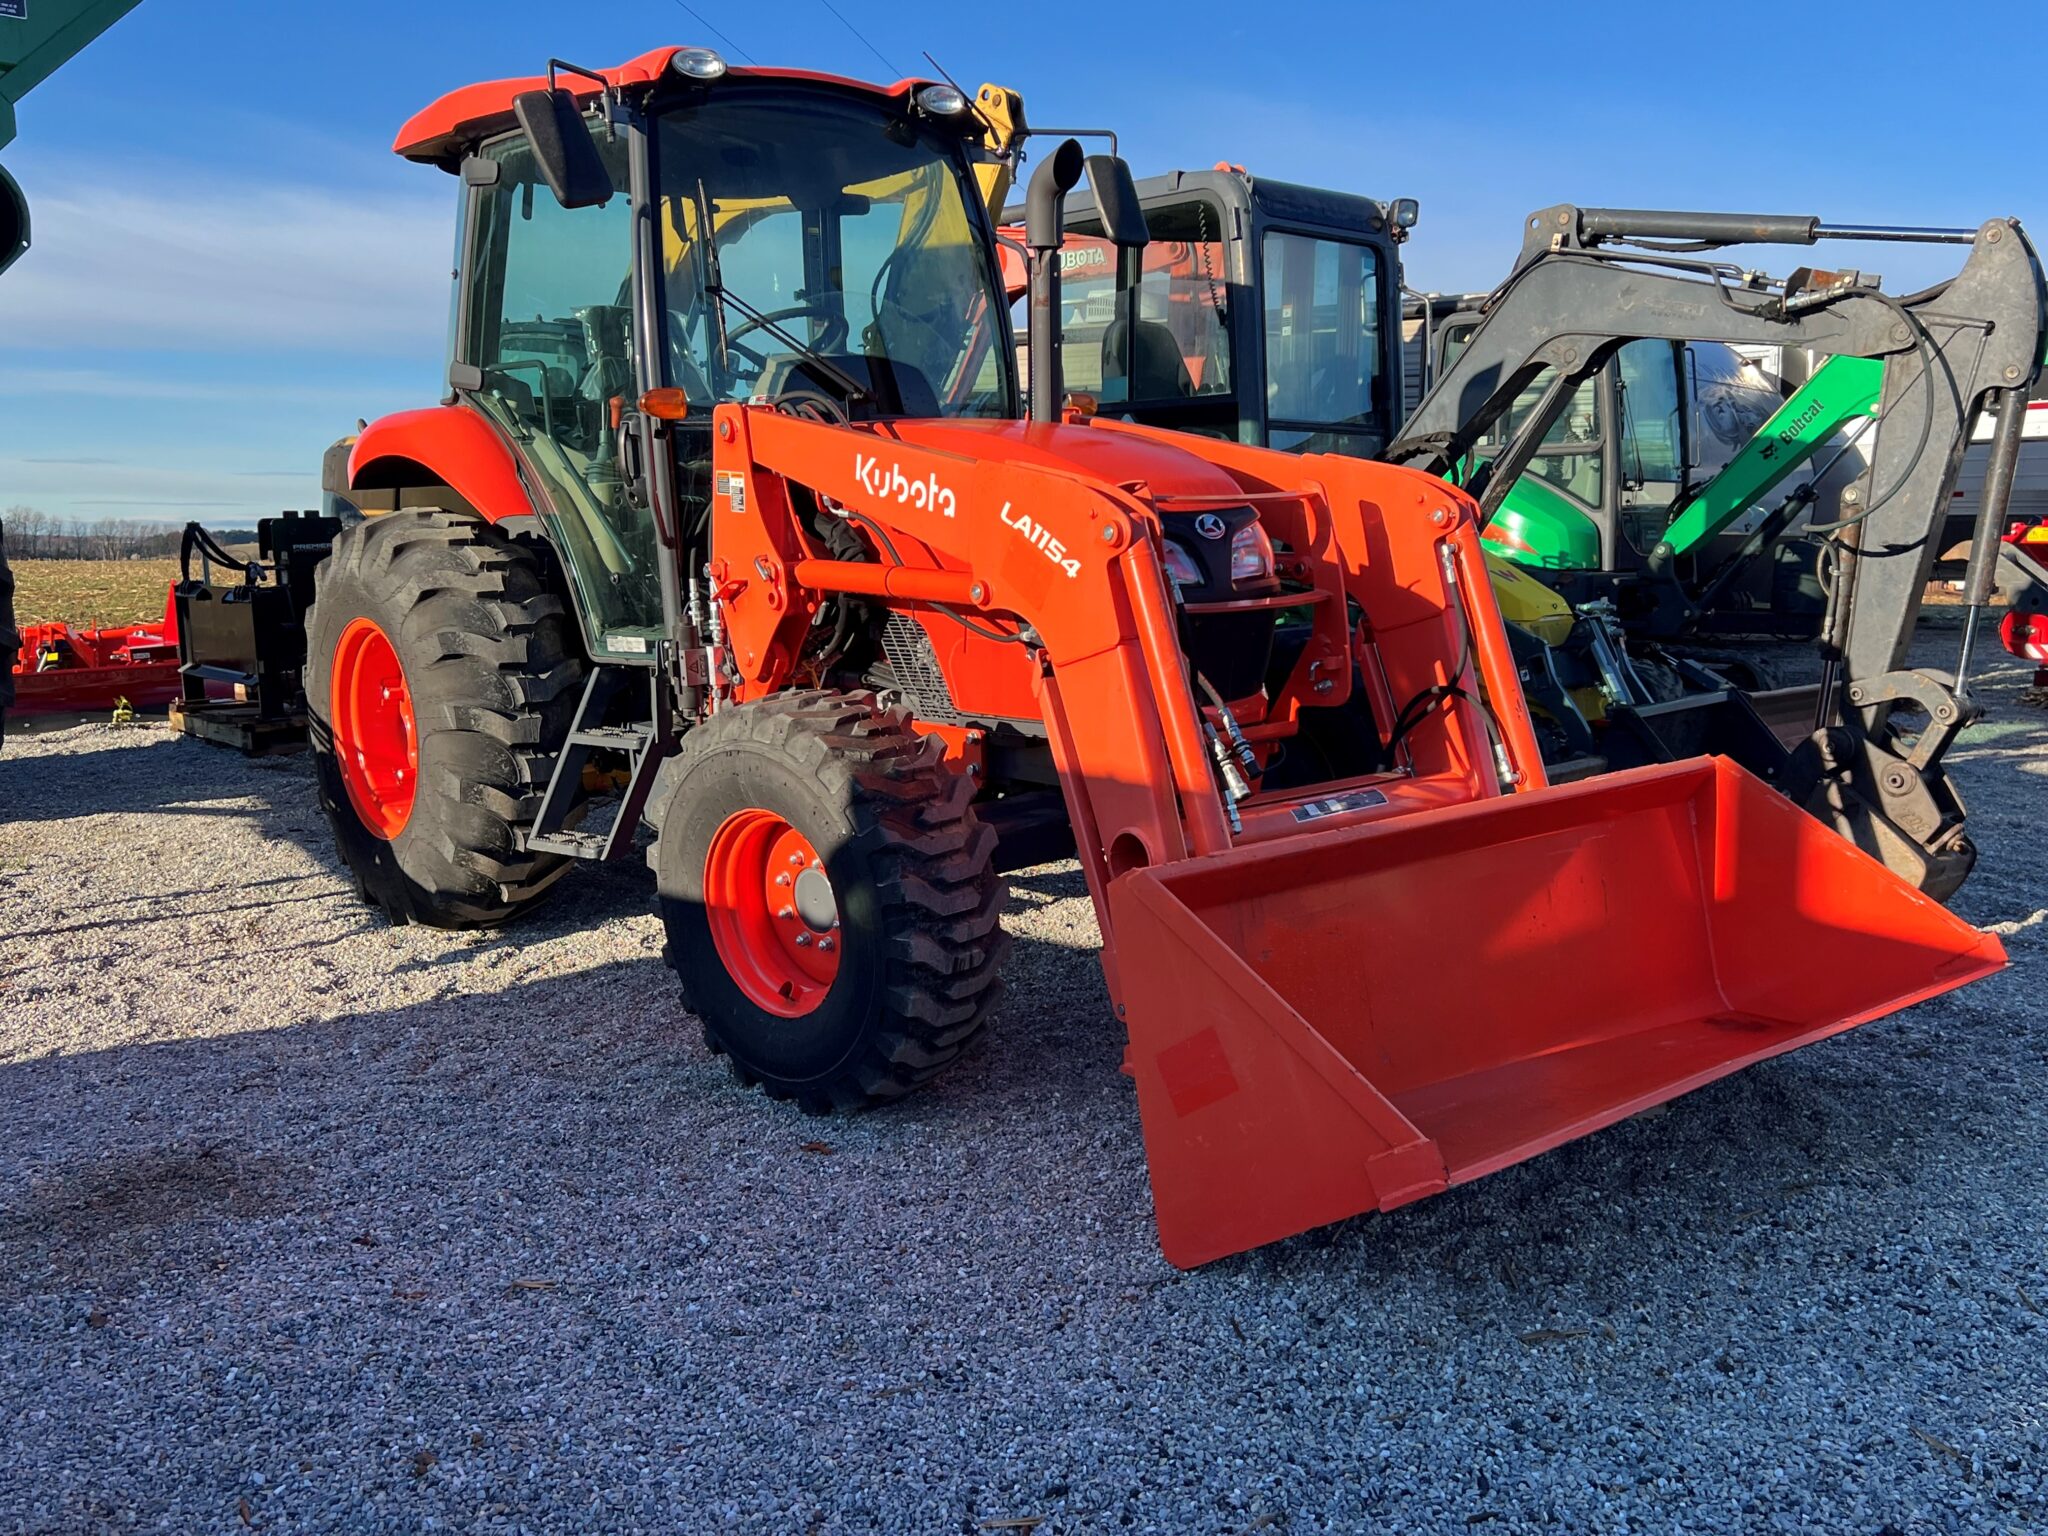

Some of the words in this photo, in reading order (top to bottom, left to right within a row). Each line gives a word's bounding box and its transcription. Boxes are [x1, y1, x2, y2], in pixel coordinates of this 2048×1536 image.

[1780, 398, 1824, 445] Bobcat
[855, 452, 956, 518] Kubota
[1000, 500, 1082, 579] LA1154
